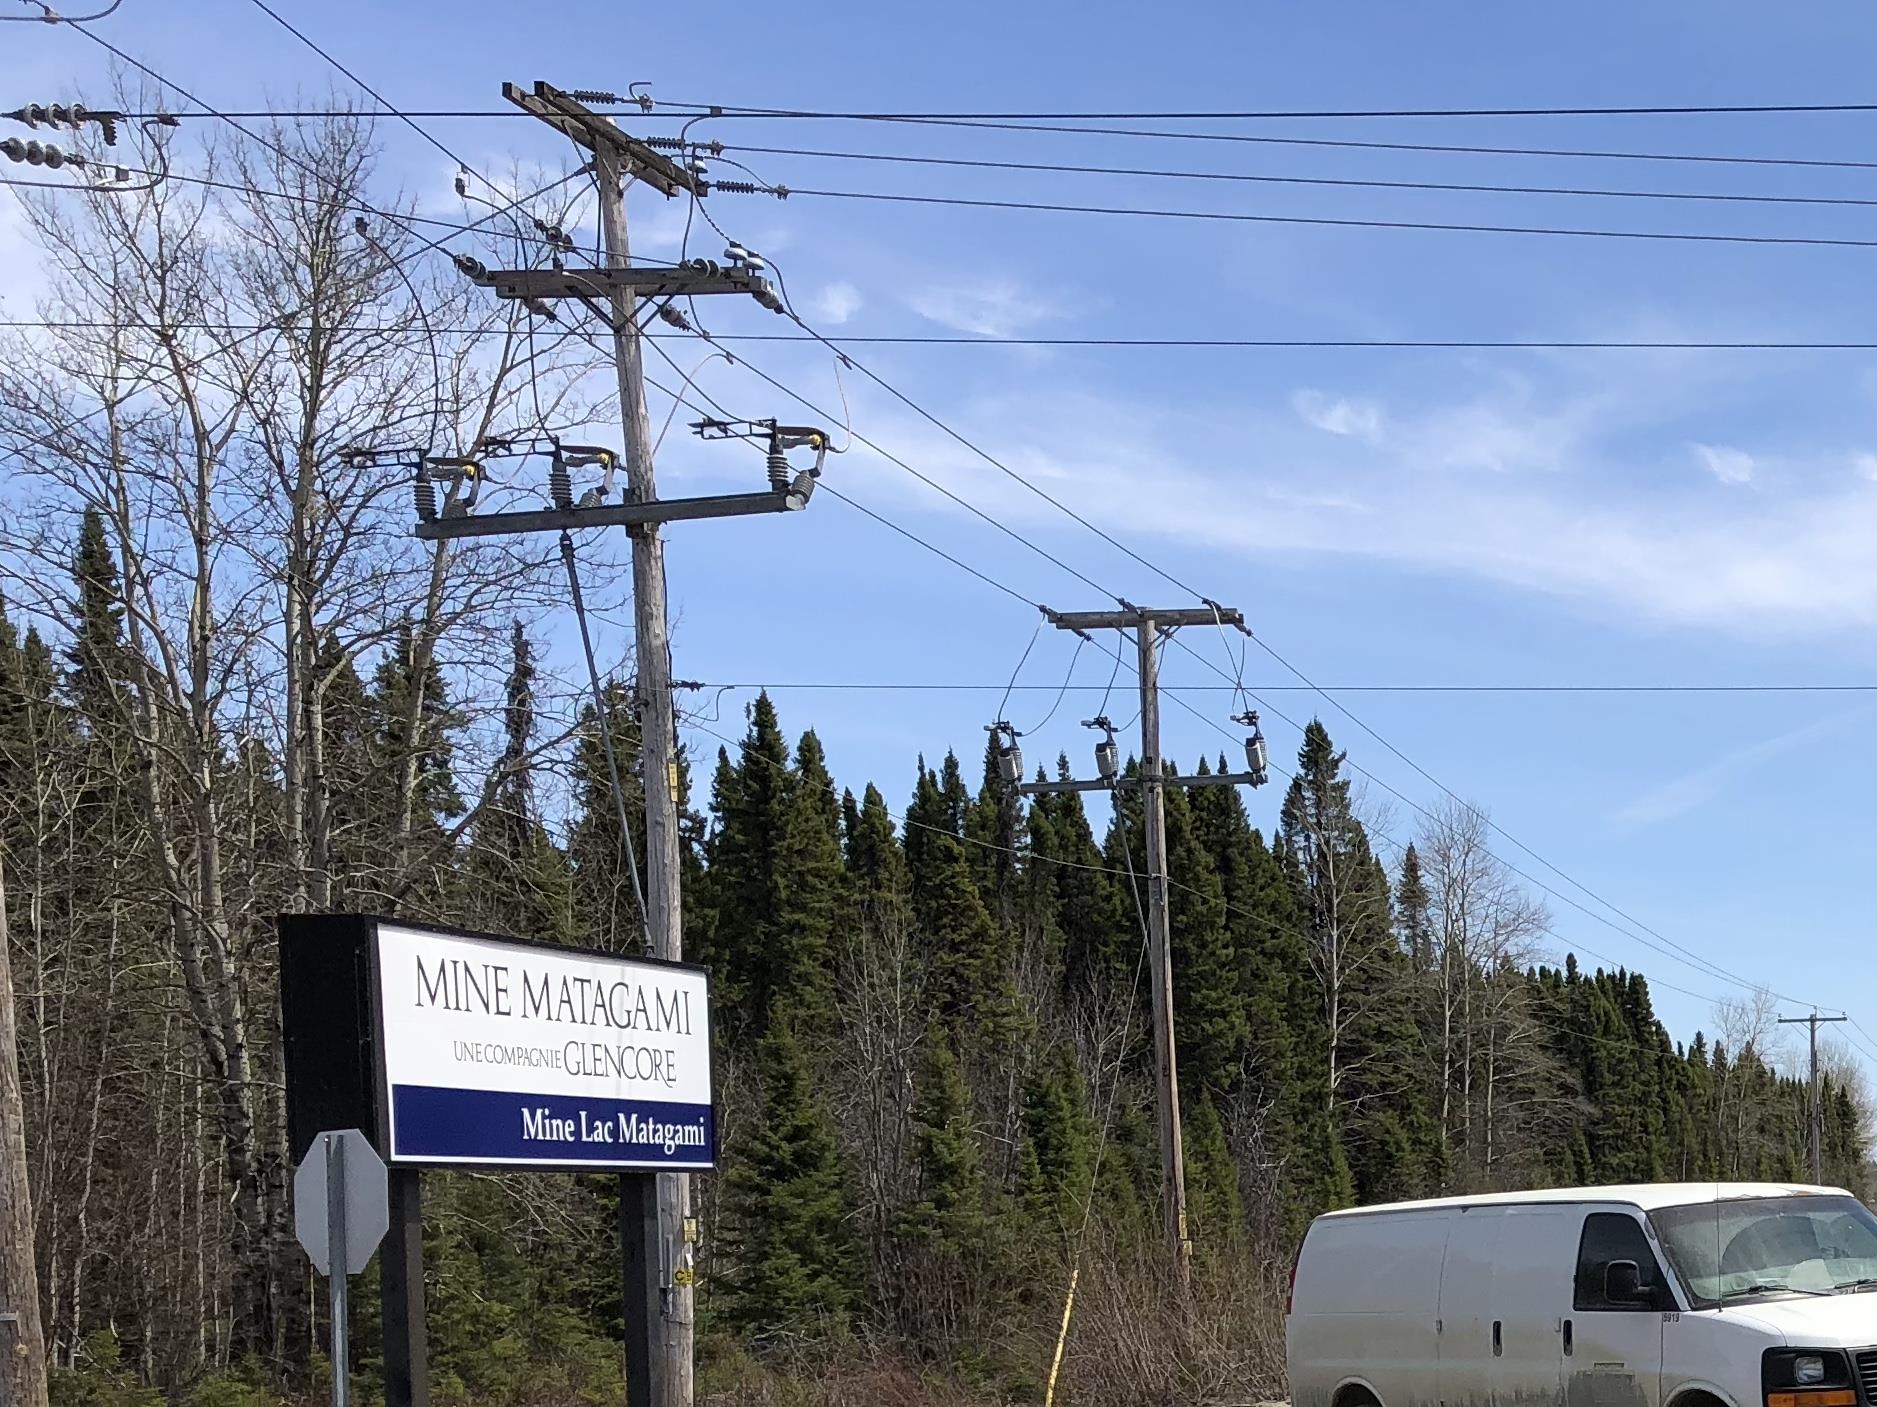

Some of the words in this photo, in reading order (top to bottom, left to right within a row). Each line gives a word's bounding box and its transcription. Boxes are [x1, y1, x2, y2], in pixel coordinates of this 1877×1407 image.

[414, 954, 512, 1017] MINE
[520, 968, 693, 1036] MATAGAMI
[453, 1040, 483, 1063] UNE
[483, 1043, 562, 1069] COMPAGNIE
[562, 1040, 677, 1088] GLENCORE
[521, 1107, 575, 1142] Mine
[579, 1110, 614, 1145] Lac
[618, 1112, 706, 1155] Matagami
